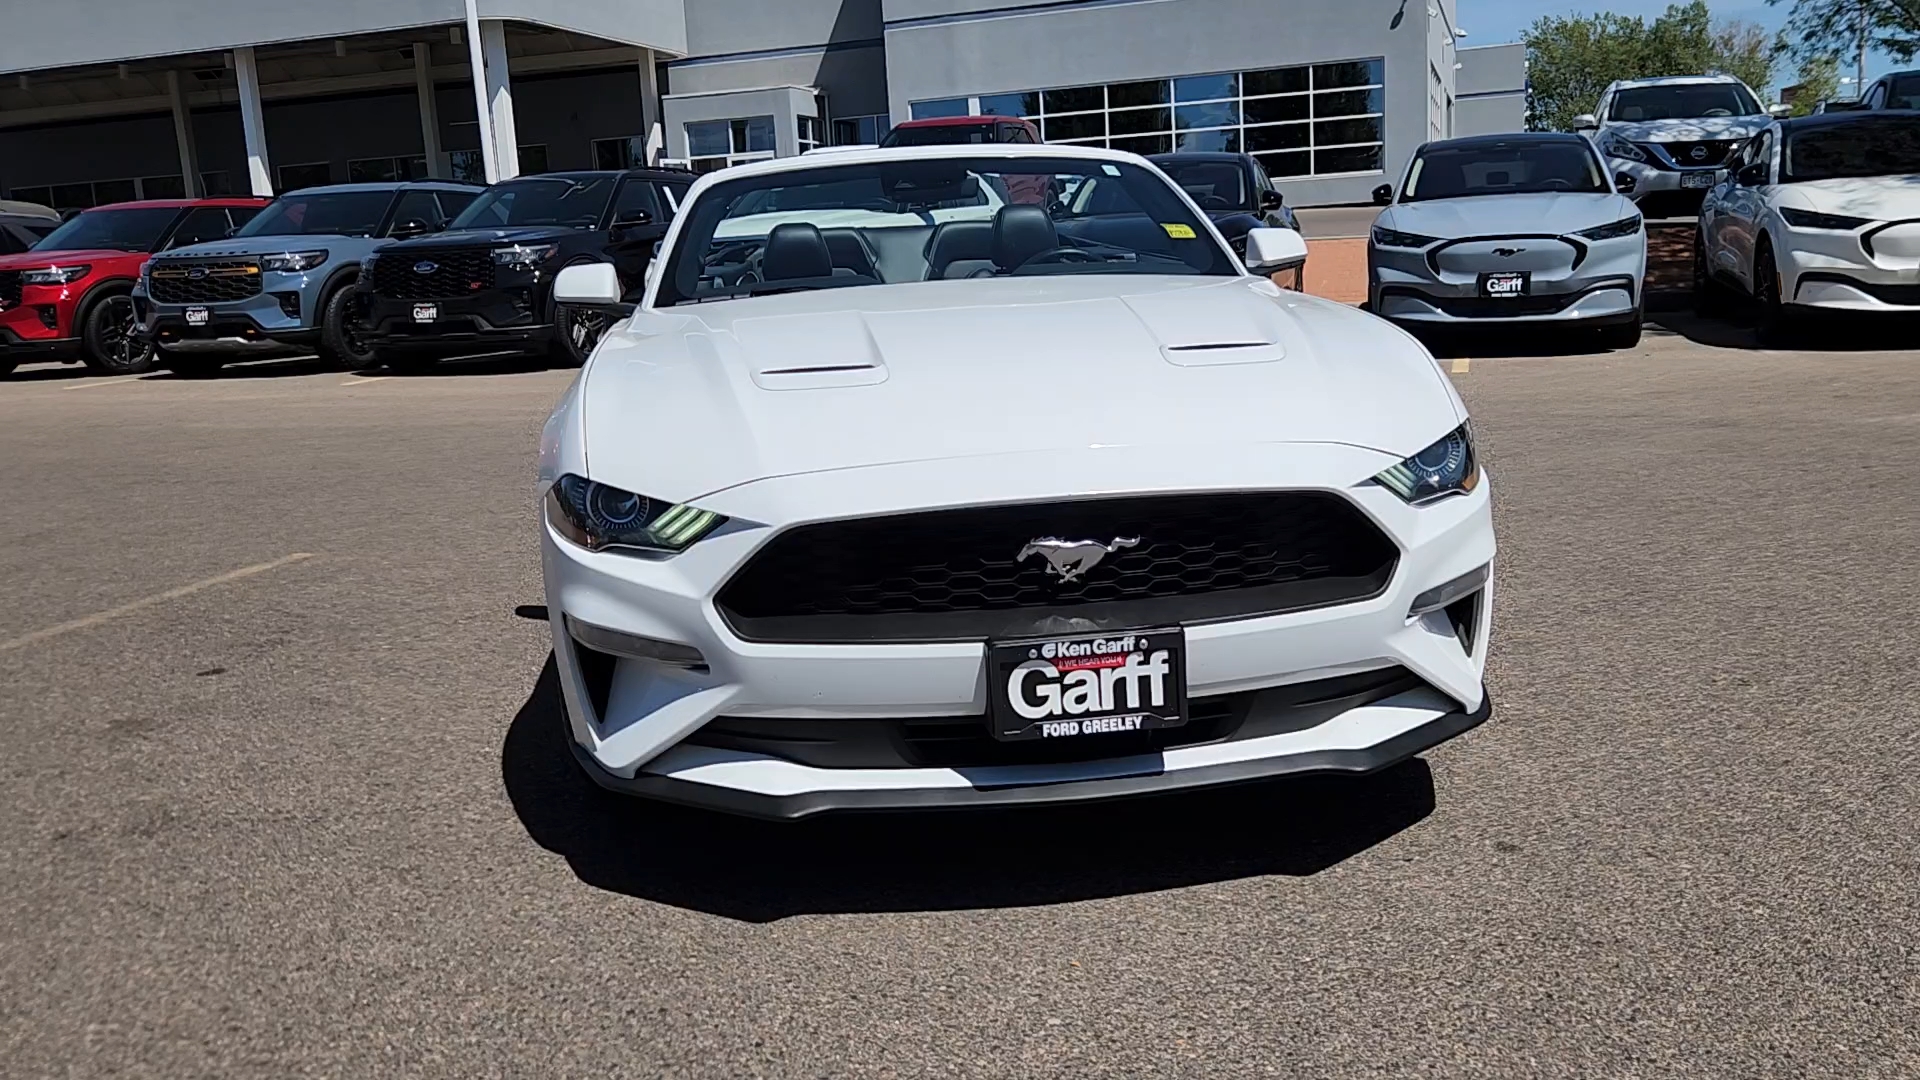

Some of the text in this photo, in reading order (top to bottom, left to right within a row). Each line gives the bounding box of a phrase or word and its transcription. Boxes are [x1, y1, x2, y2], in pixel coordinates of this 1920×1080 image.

[1487, 278, 1522, 292] Garff
[413, 307, 437, 319] Garff
[1057, 641, 1091, 658] Ken
[1092, 636, 1136, 655] Garff
[1008, 650, 1169, 719] Garff
[1043, 716, 1143, 738] FORD GREELEY
